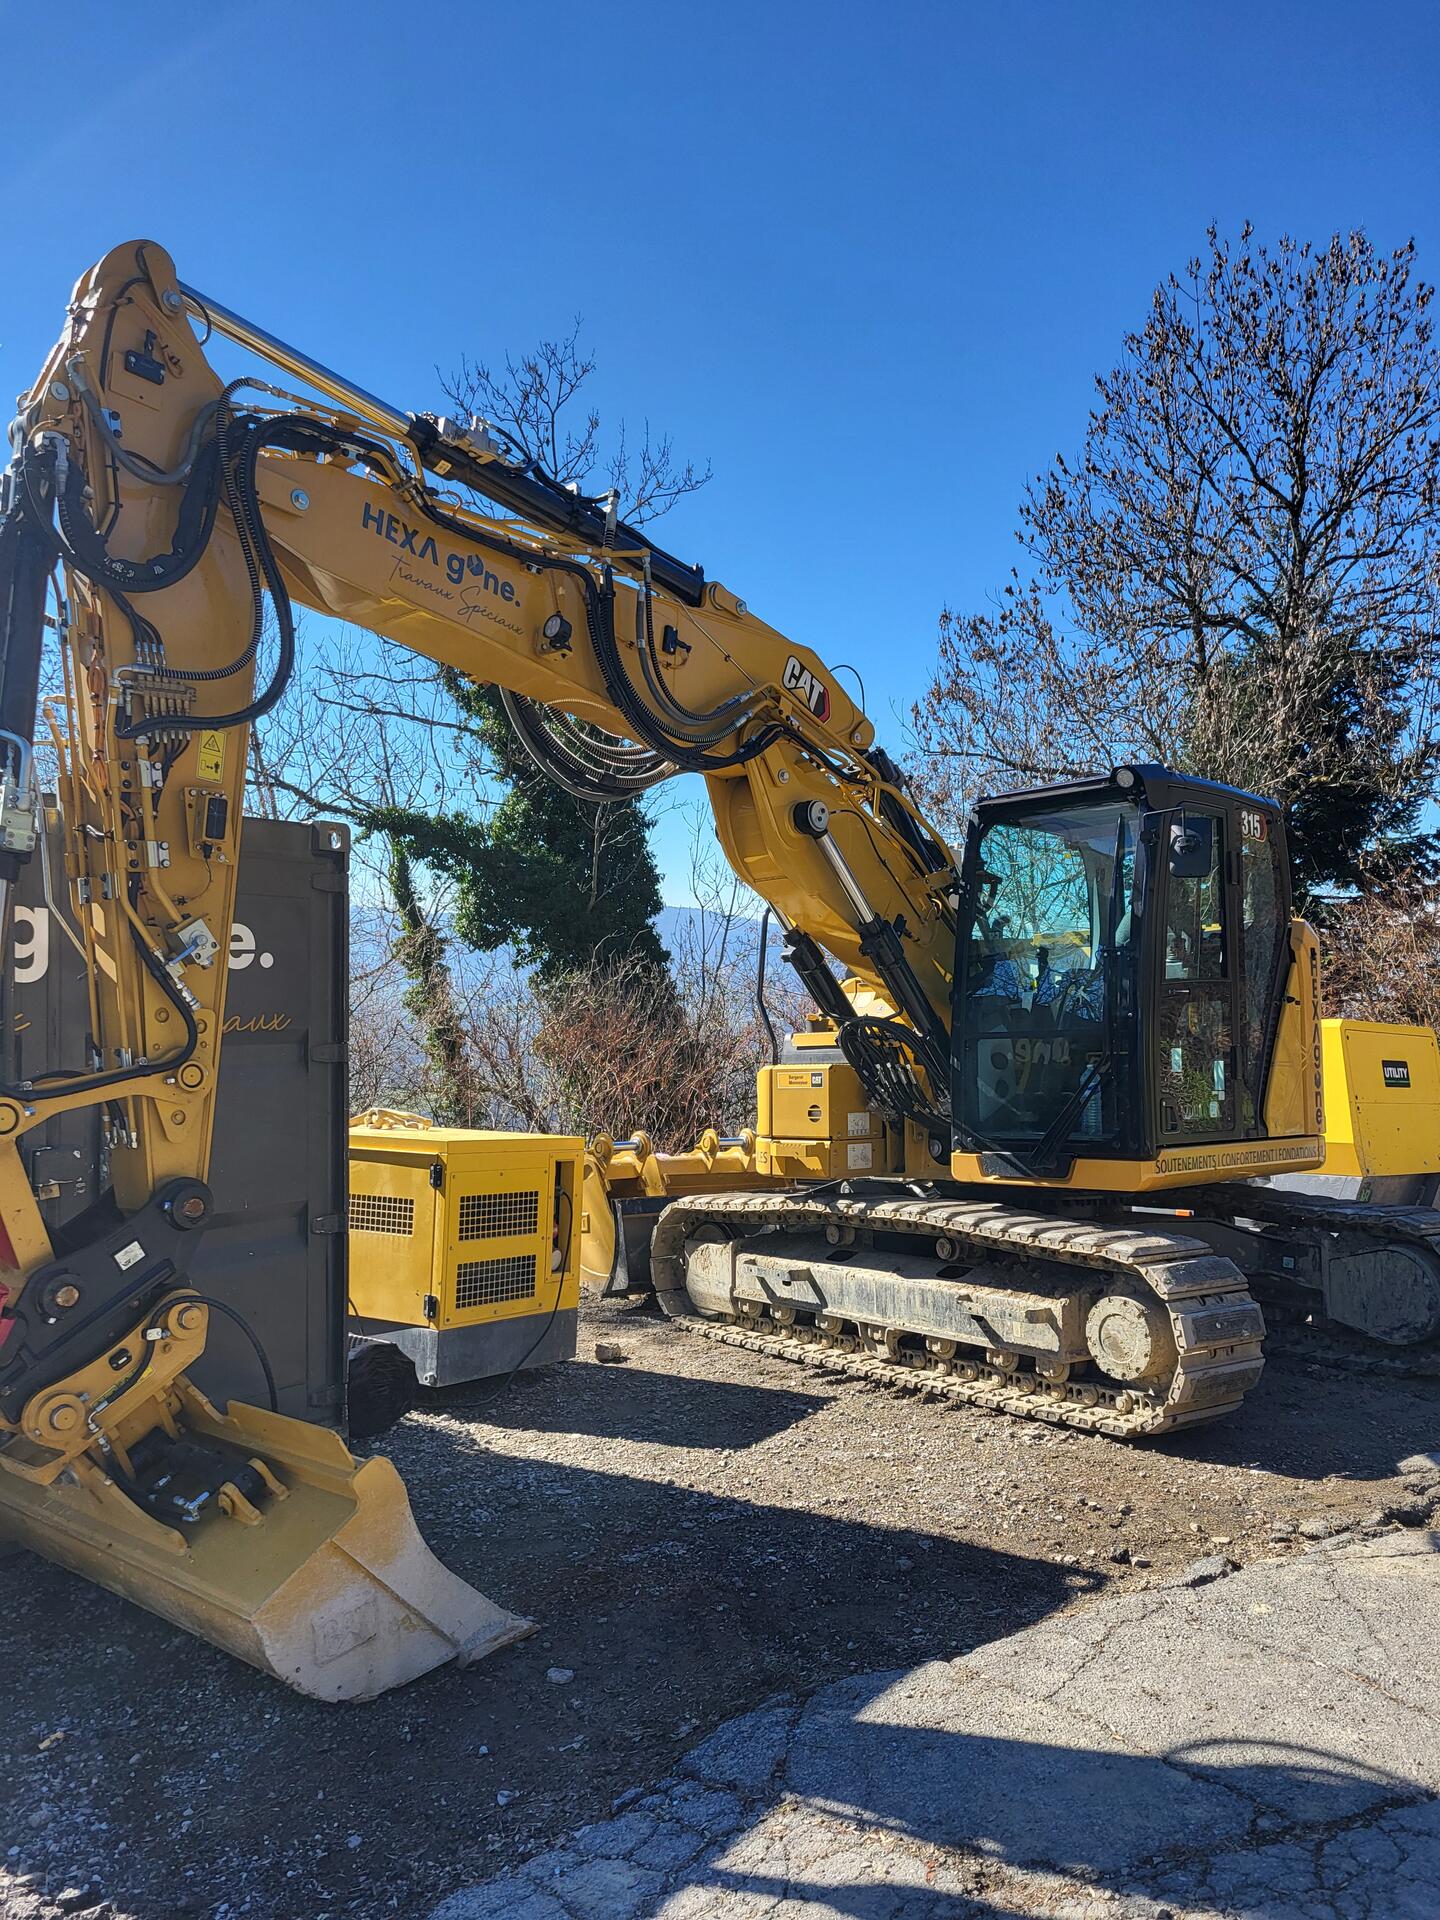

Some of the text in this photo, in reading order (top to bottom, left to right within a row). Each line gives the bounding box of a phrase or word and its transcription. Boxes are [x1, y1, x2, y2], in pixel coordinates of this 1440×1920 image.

[389, 555, 454, 600] Travaux
[783, 656, 825, 712] CAT
[1242, 810, 1261, 838] 315
[811, 1076, 822, 1084] CAT
[1384, 1067, 1408, 1078] UTILITY
[1155, 1145, 1317, 1174] SOUTENEMENTS CONFORTEMENT FONDATIONS
